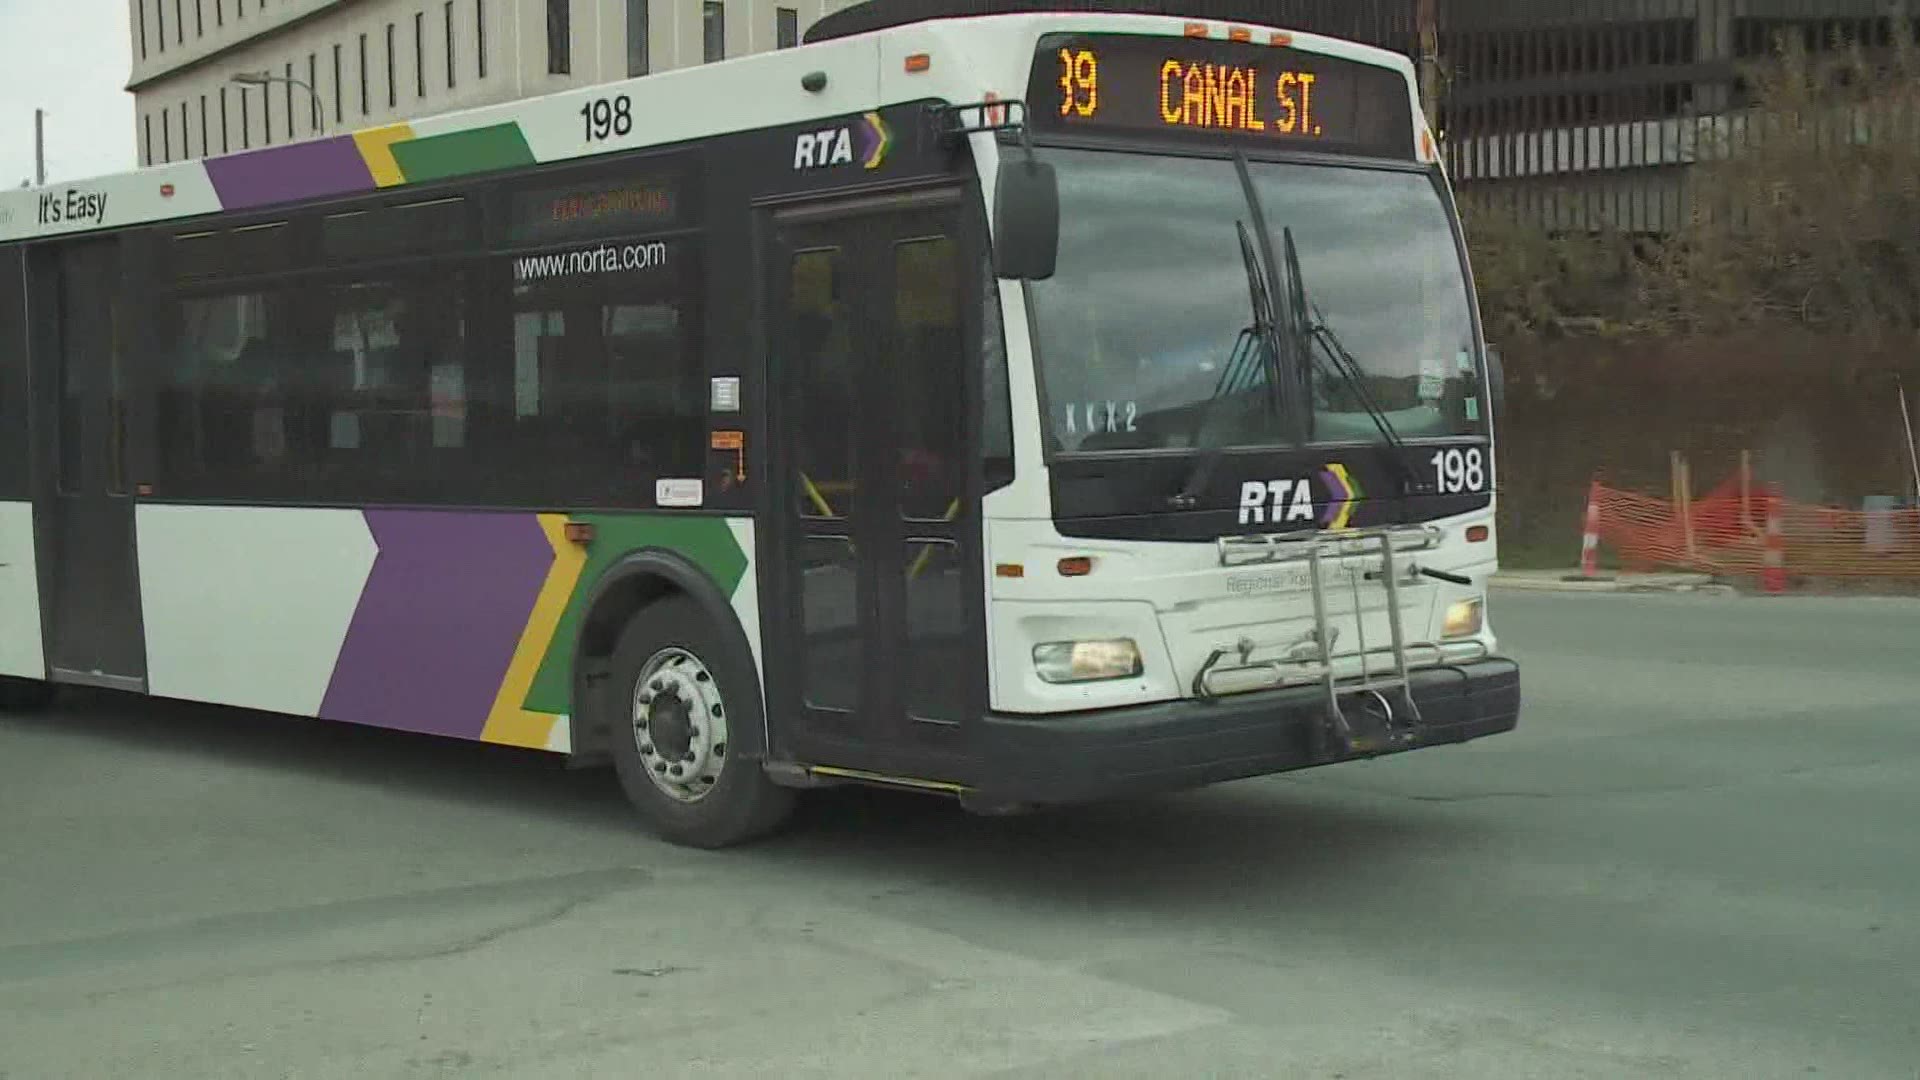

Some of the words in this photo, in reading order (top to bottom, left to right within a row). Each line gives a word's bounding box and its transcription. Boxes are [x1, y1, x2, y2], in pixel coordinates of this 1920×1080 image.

[580, 95, 632, 142] 198
[1160, 59, 1266, 131] CANAL
[1276, 71, 1322, 135] ST.
[793, 127, 853, 169] RTA
[38, 191, 62, 225] It's
[66, 189, 108, 224] Easy
[518, 241, 666, 280] www.norta.com
[1430, 448, 1484, 493] 198
[1238, 478, 1315, 525] RTA
